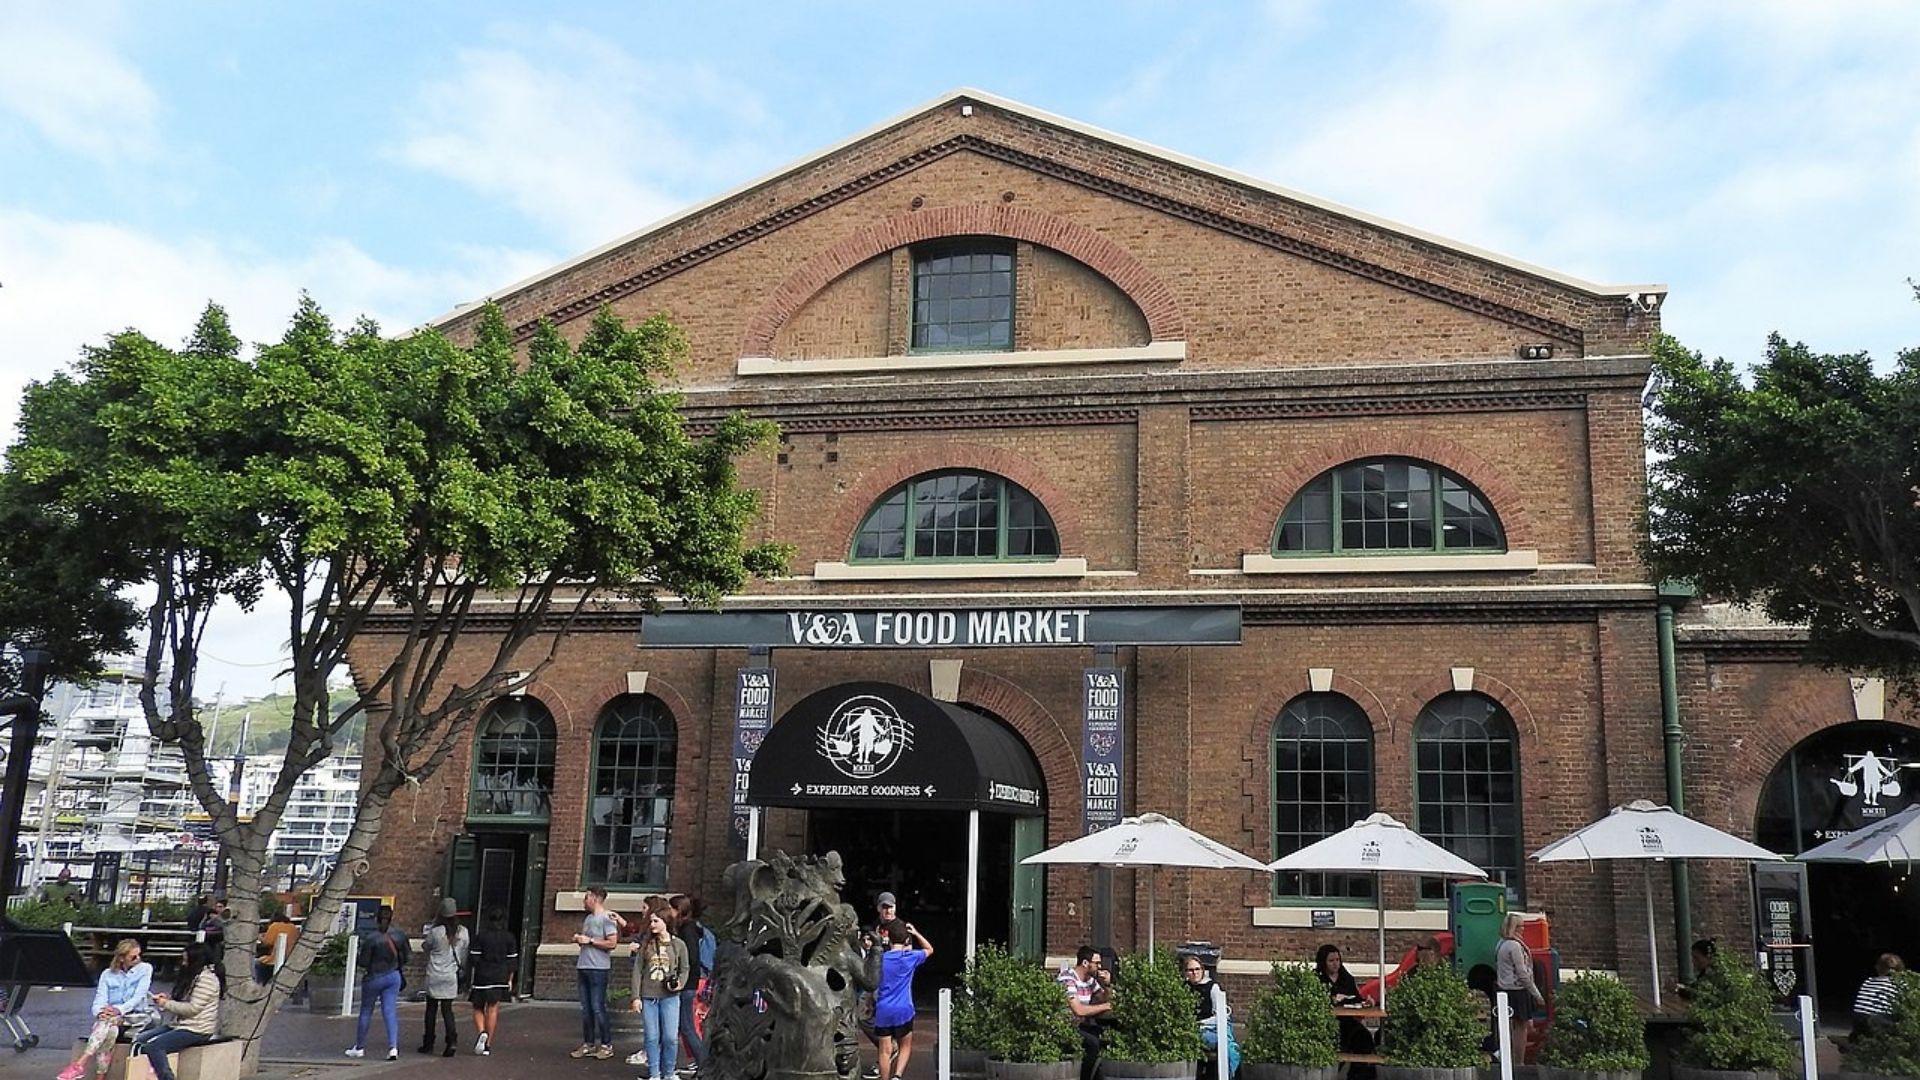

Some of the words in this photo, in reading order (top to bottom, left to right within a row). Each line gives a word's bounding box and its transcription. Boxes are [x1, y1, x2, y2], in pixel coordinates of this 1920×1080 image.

[788, 612, 864, 644] V&A
[875, 612, 955, 644] FOOD
[967, 609, 1090, 644] MARKET
[741, 674, 770, 687] V&A
[1087, 674, 1119, 688] V&A
[741, 688, 769, 705] FOOD
[1088, 688, 1118, 707] FOOD
[739, 707, 767, 719] MARKET
[1088, 710, 1118, 720] MARKET
[736, 758, 751, 772] V&
[1086, 762, 1118, 777] V&A
[735, 773, 749, 790] FO
[1087, 777, 1117, 796] FOOD
[806, 784, 869, 796] EXPERIENCE
[871, 785, 921, 796] GOODNESS
[1086, 798, 1117, 810] MARKET
